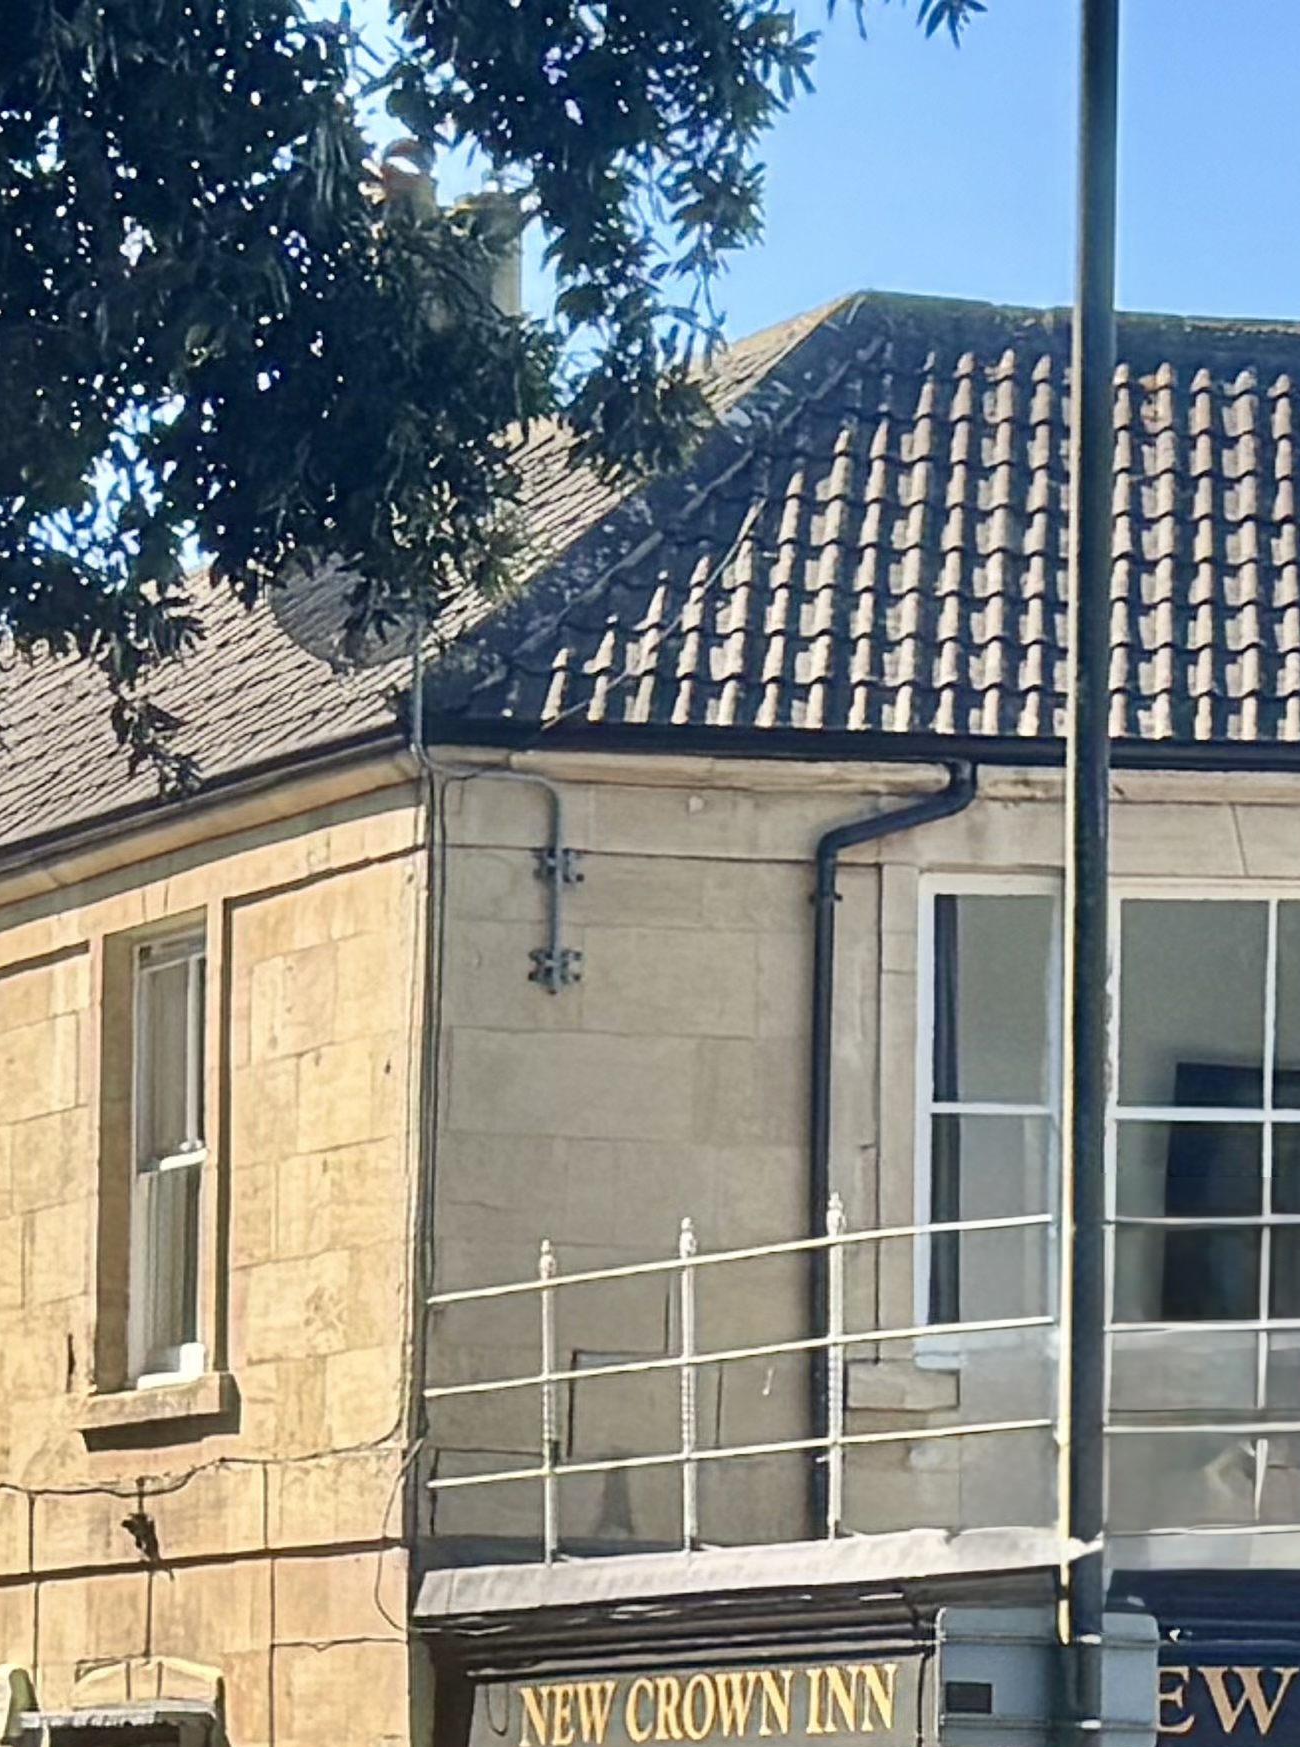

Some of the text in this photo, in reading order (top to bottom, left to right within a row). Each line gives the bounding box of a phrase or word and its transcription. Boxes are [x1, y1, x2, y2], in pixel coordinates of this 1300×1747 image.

[518, 1662, 898, 1747] NEW CROWN INN
[1157, 1666, 1300, 1735] EW
